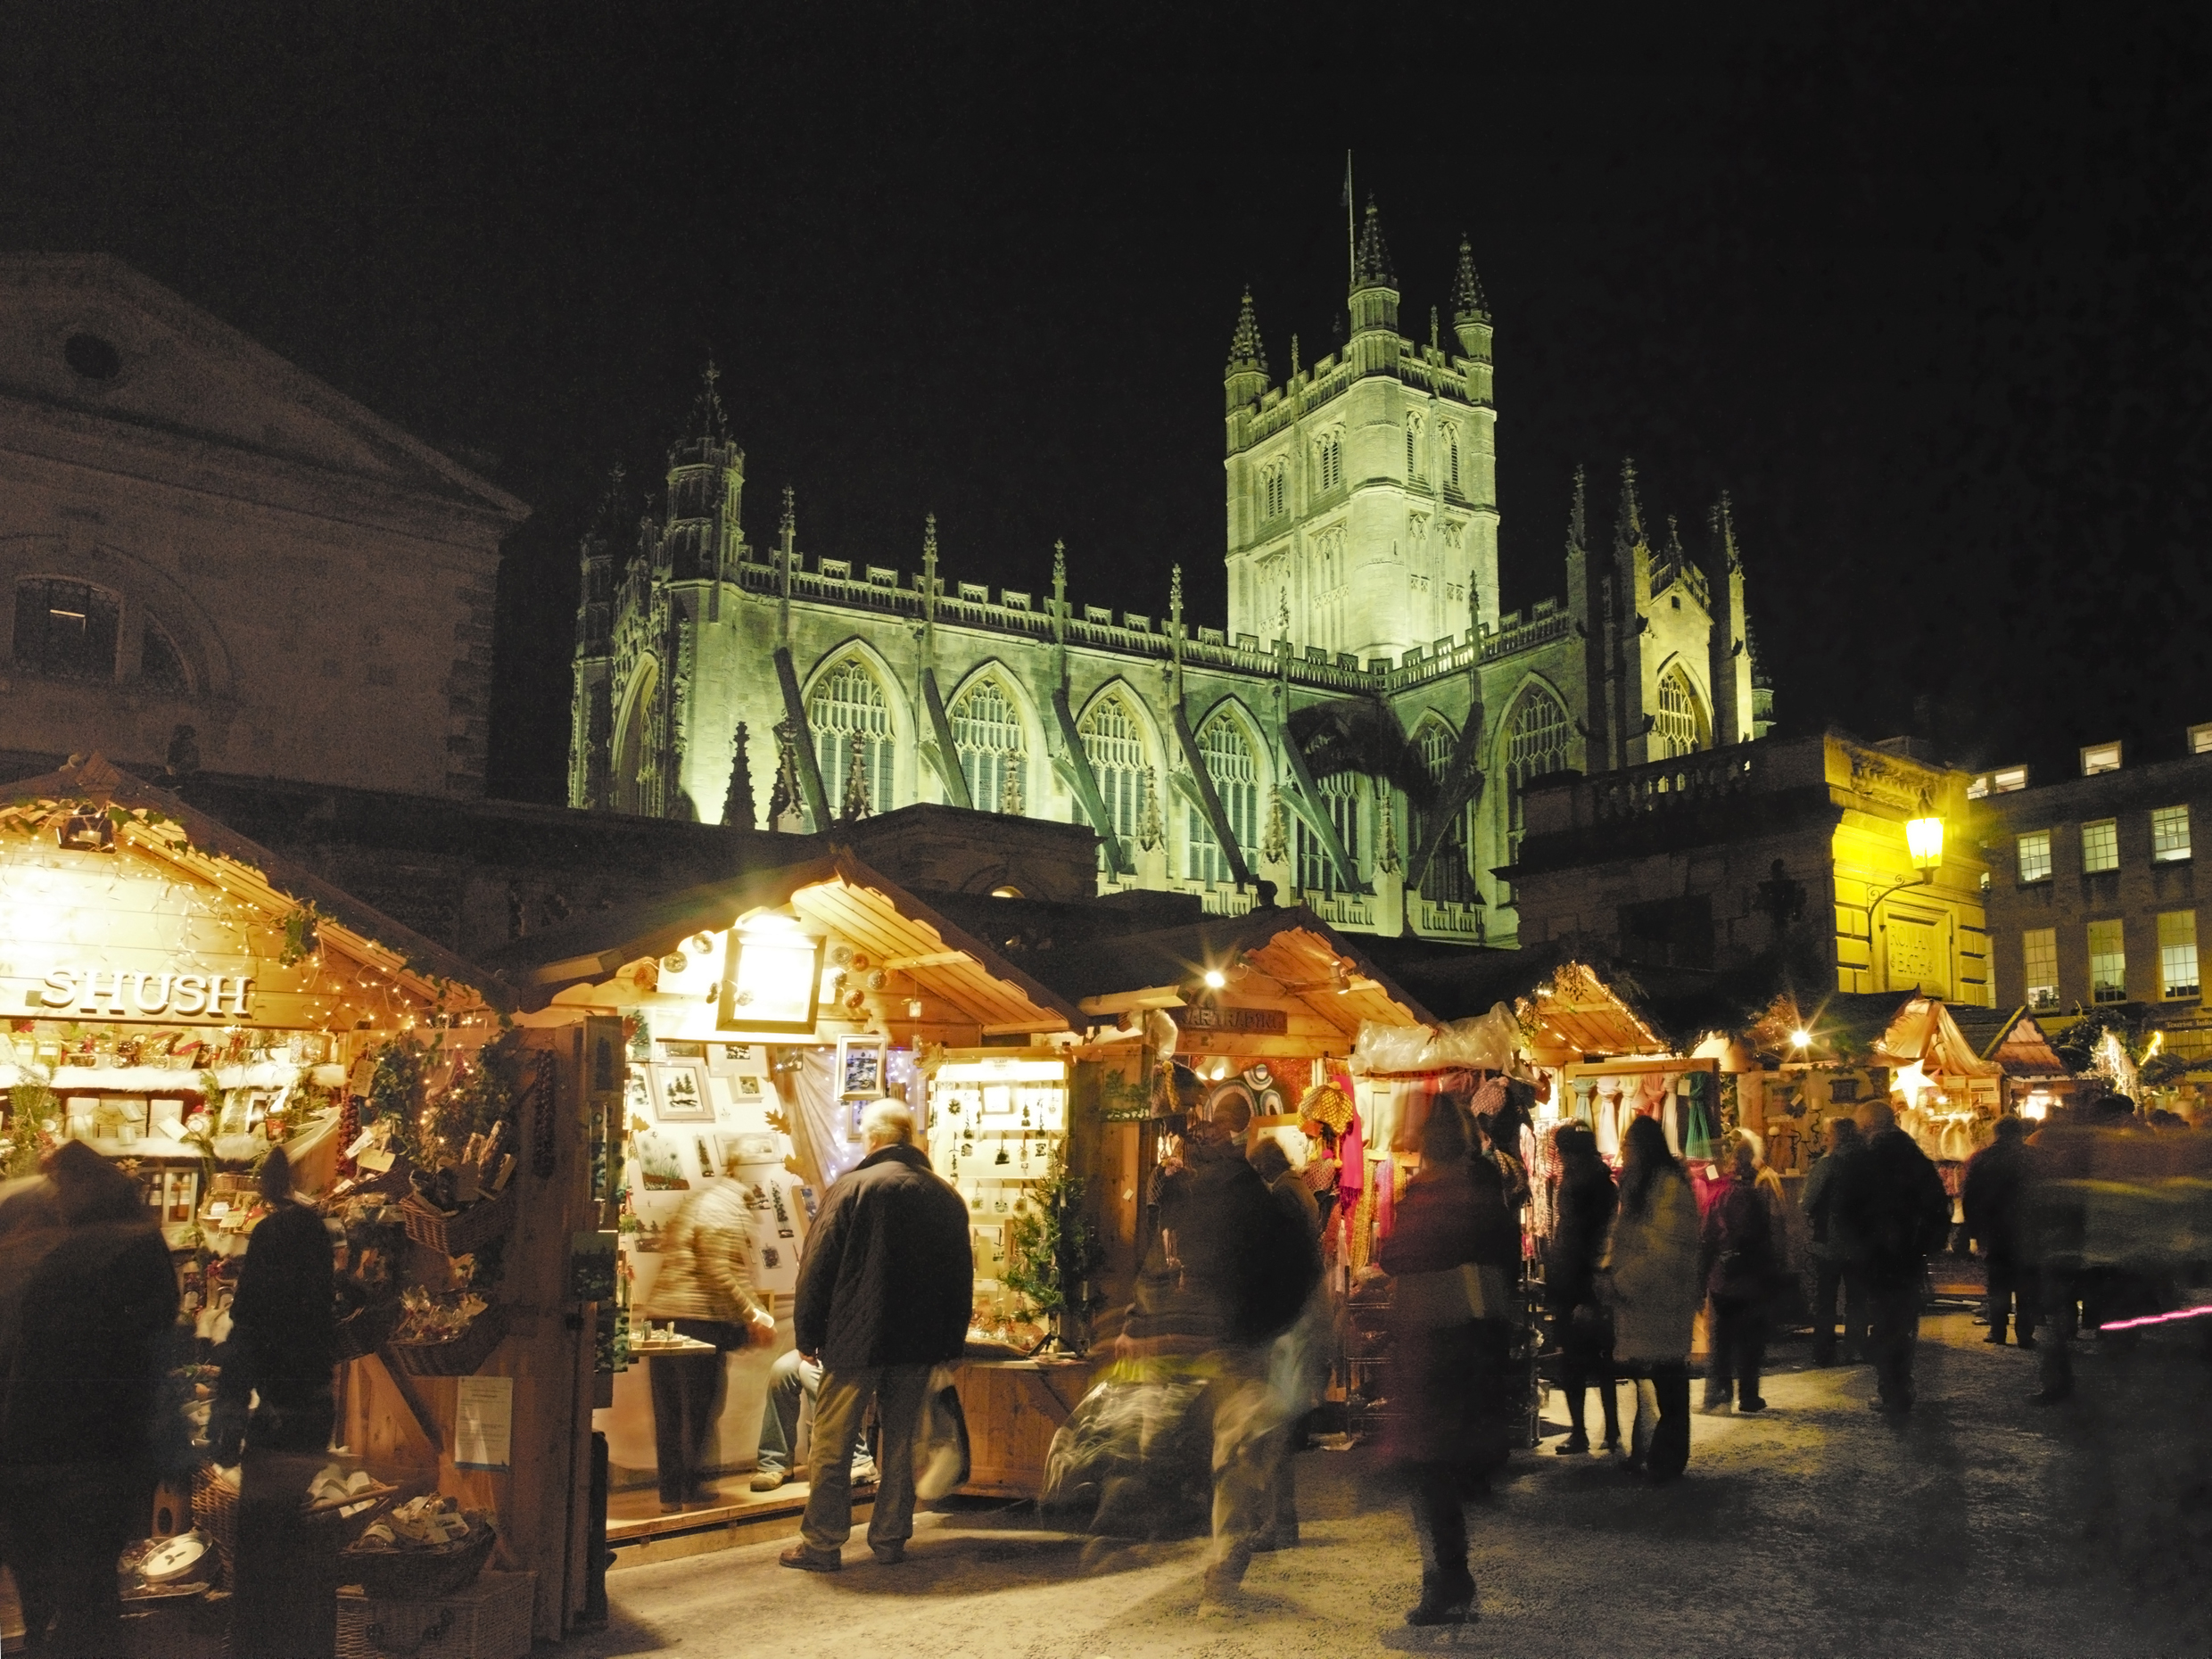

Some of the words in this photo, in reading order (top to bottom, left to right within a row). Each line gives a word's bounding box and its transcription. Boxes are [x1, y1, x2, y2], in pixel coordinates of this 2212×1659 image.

[1889, 925, 1932, 951] ROMAN
[1897, 953, 1927, 976] BATH
[41, 966, 255, 1019] SHUSH
